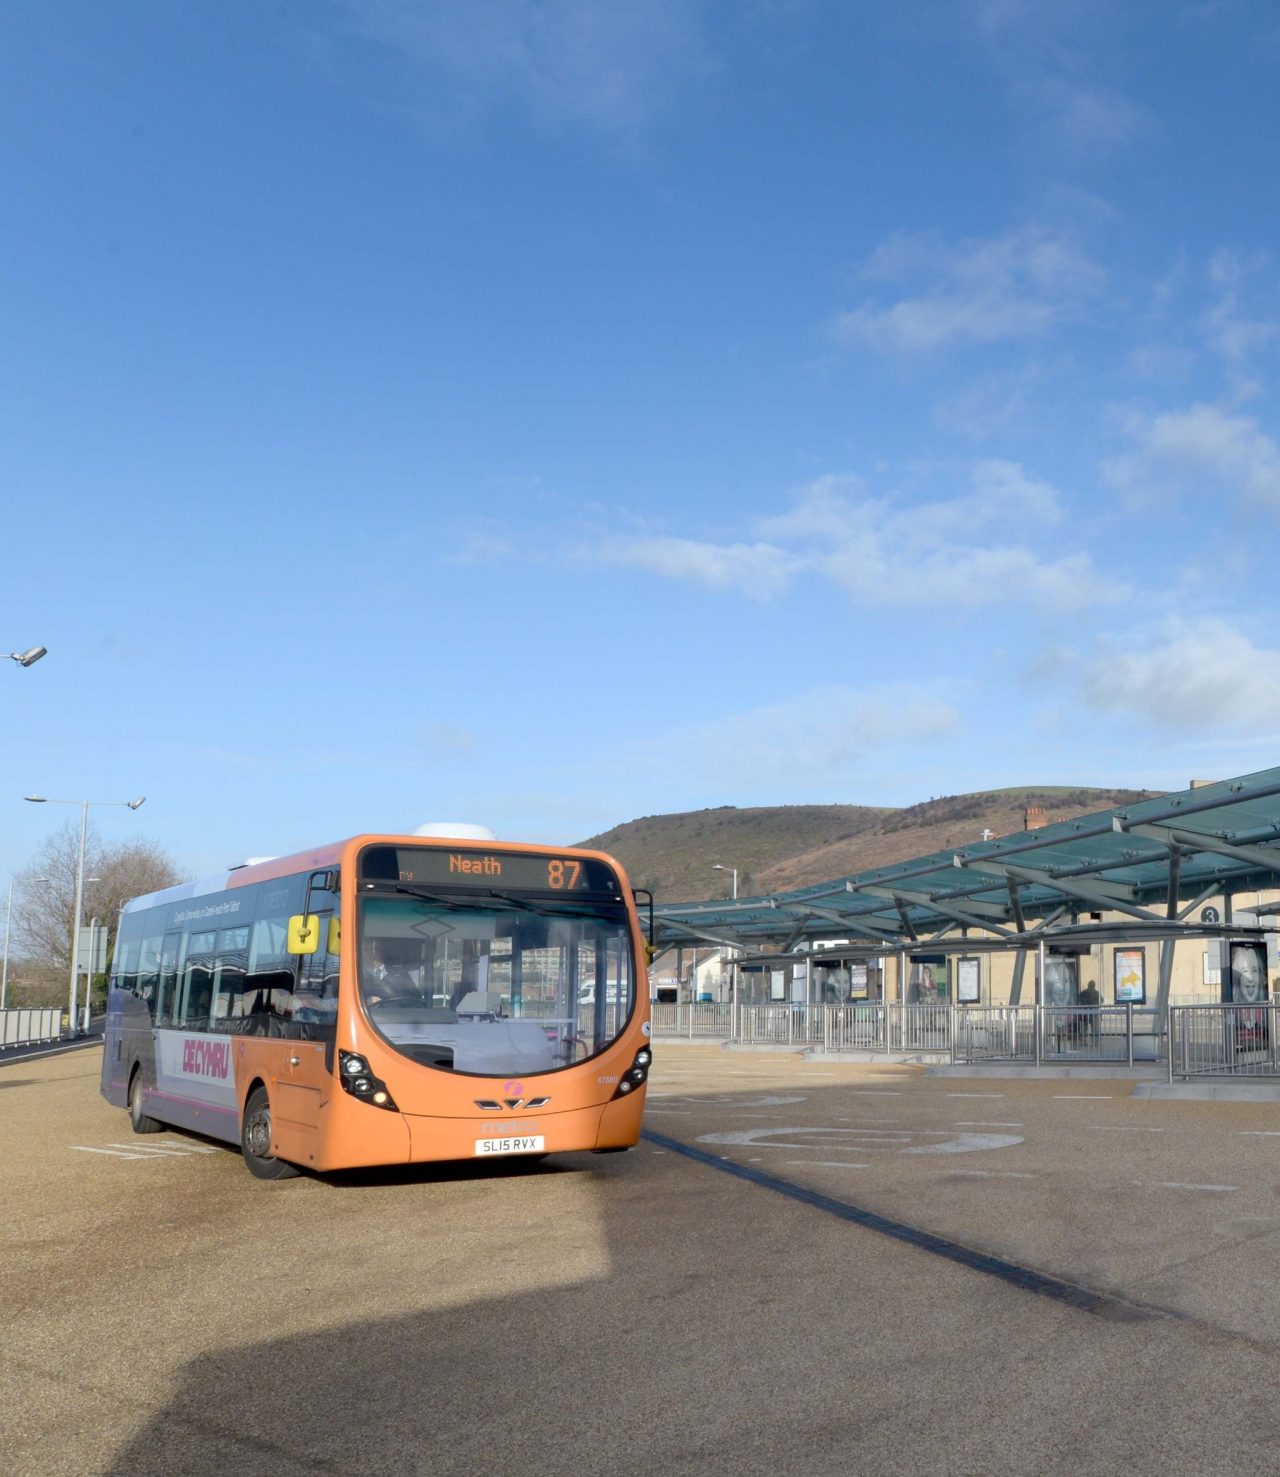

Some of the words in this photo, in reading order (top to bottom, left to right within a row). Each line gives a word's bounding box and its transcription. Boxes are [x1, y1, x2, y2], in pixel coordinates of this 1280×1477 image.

[449, 855, 502, 875] Neath
[548, 859, 581, 889] 87
[1206, 909, 1215, 925] 3
[483, 1138, 511, 1152] SL15
[513, 1137, 537, 1149] RVX
